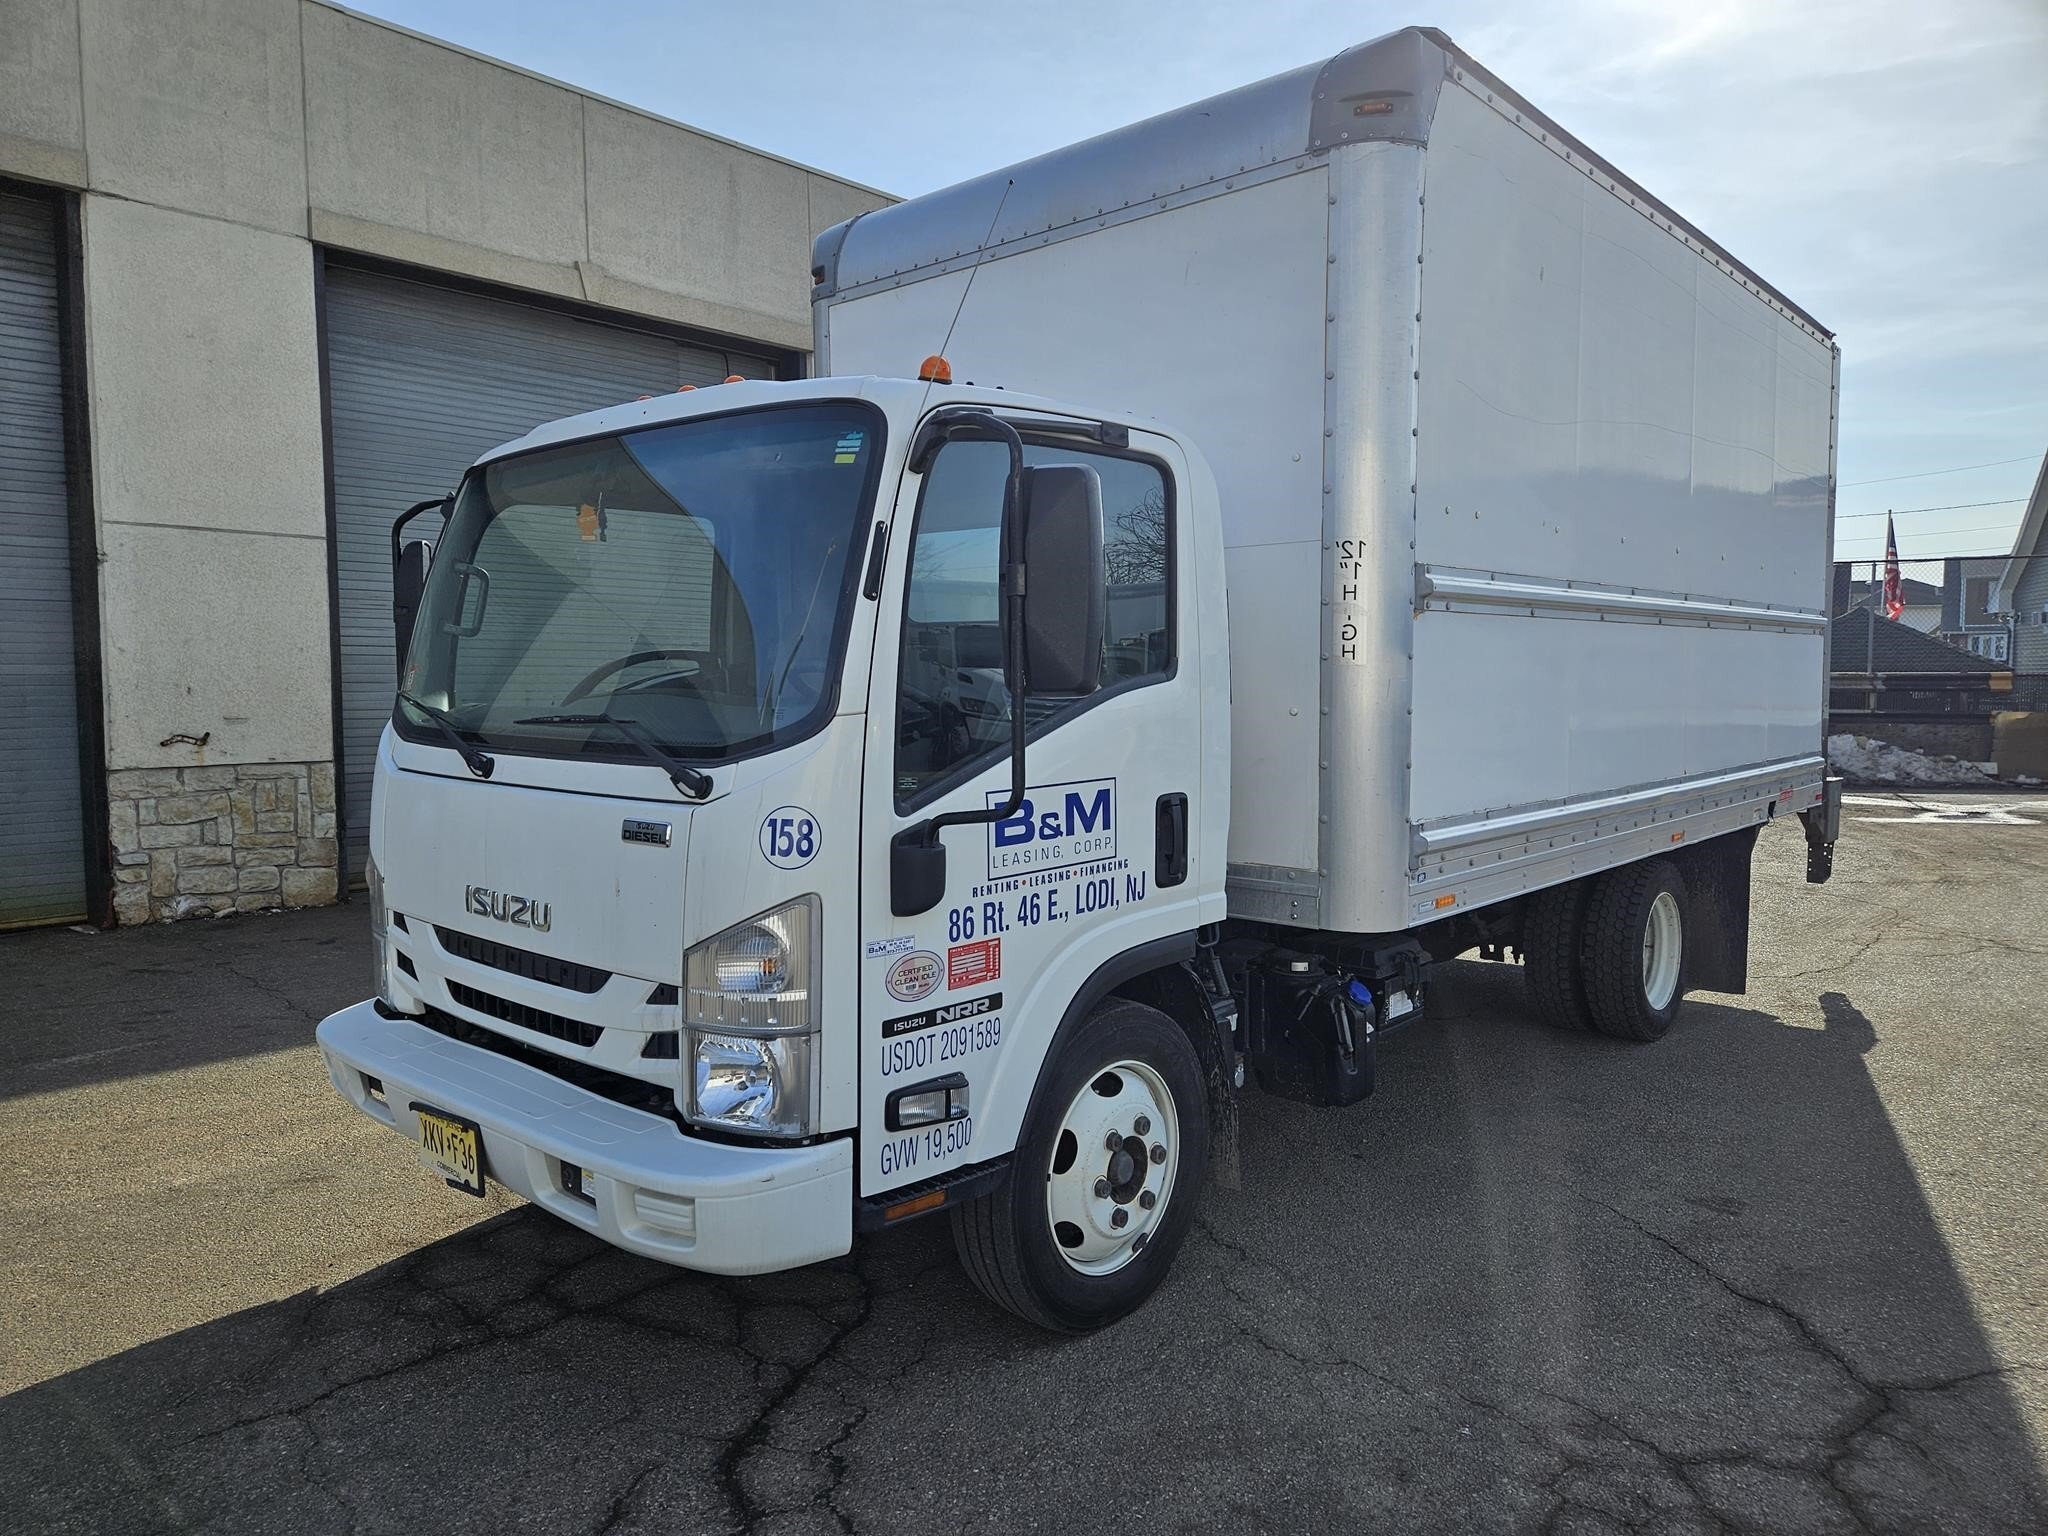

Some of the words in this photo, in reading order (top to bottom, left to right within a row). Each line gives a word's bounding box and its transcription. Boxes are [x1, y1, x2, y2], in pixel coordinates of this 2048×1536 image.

[623, 830, 668, 845] DIESEL
[994, 788, 1111, 848] B&M
[767, 818, 814, 858] 158
[992, 845, 1064, 869] LEASING,
[1074, 837, 1114, 855] CORP.
[972, 880, 1019, 898] RENTING
[1029, 870, 1071, 888] LEASING
[1080, 859, 1129, 877] FINANCING
[465, 884, 552, 933] ISUZU
[948, 906, 975, 943] 86
[983, 901, 1010, 936] Rt.
[1017, 893, 1041, 927] 46
[1048, 889, 1069, 923] E.,
[1075, 877, 1120, 915] LODI,
[1126, 871, 1146, 903] NJ
[895, 976, 919, 987] CLEAN
[922, 971, 936, 980] IDLE
[898, 964, 933, 977] CERTIFIED
[894, 1017, 926, 1032] ISUZU
[936, 999, 990, 1023] NRR
[881, 1034, 937, 1076] USDOT
[941, 1017, 1001, 1061] 2091589
[881, 1134, 919, 1175] GVW
[925, 1117, 972, 1161] 19,500
